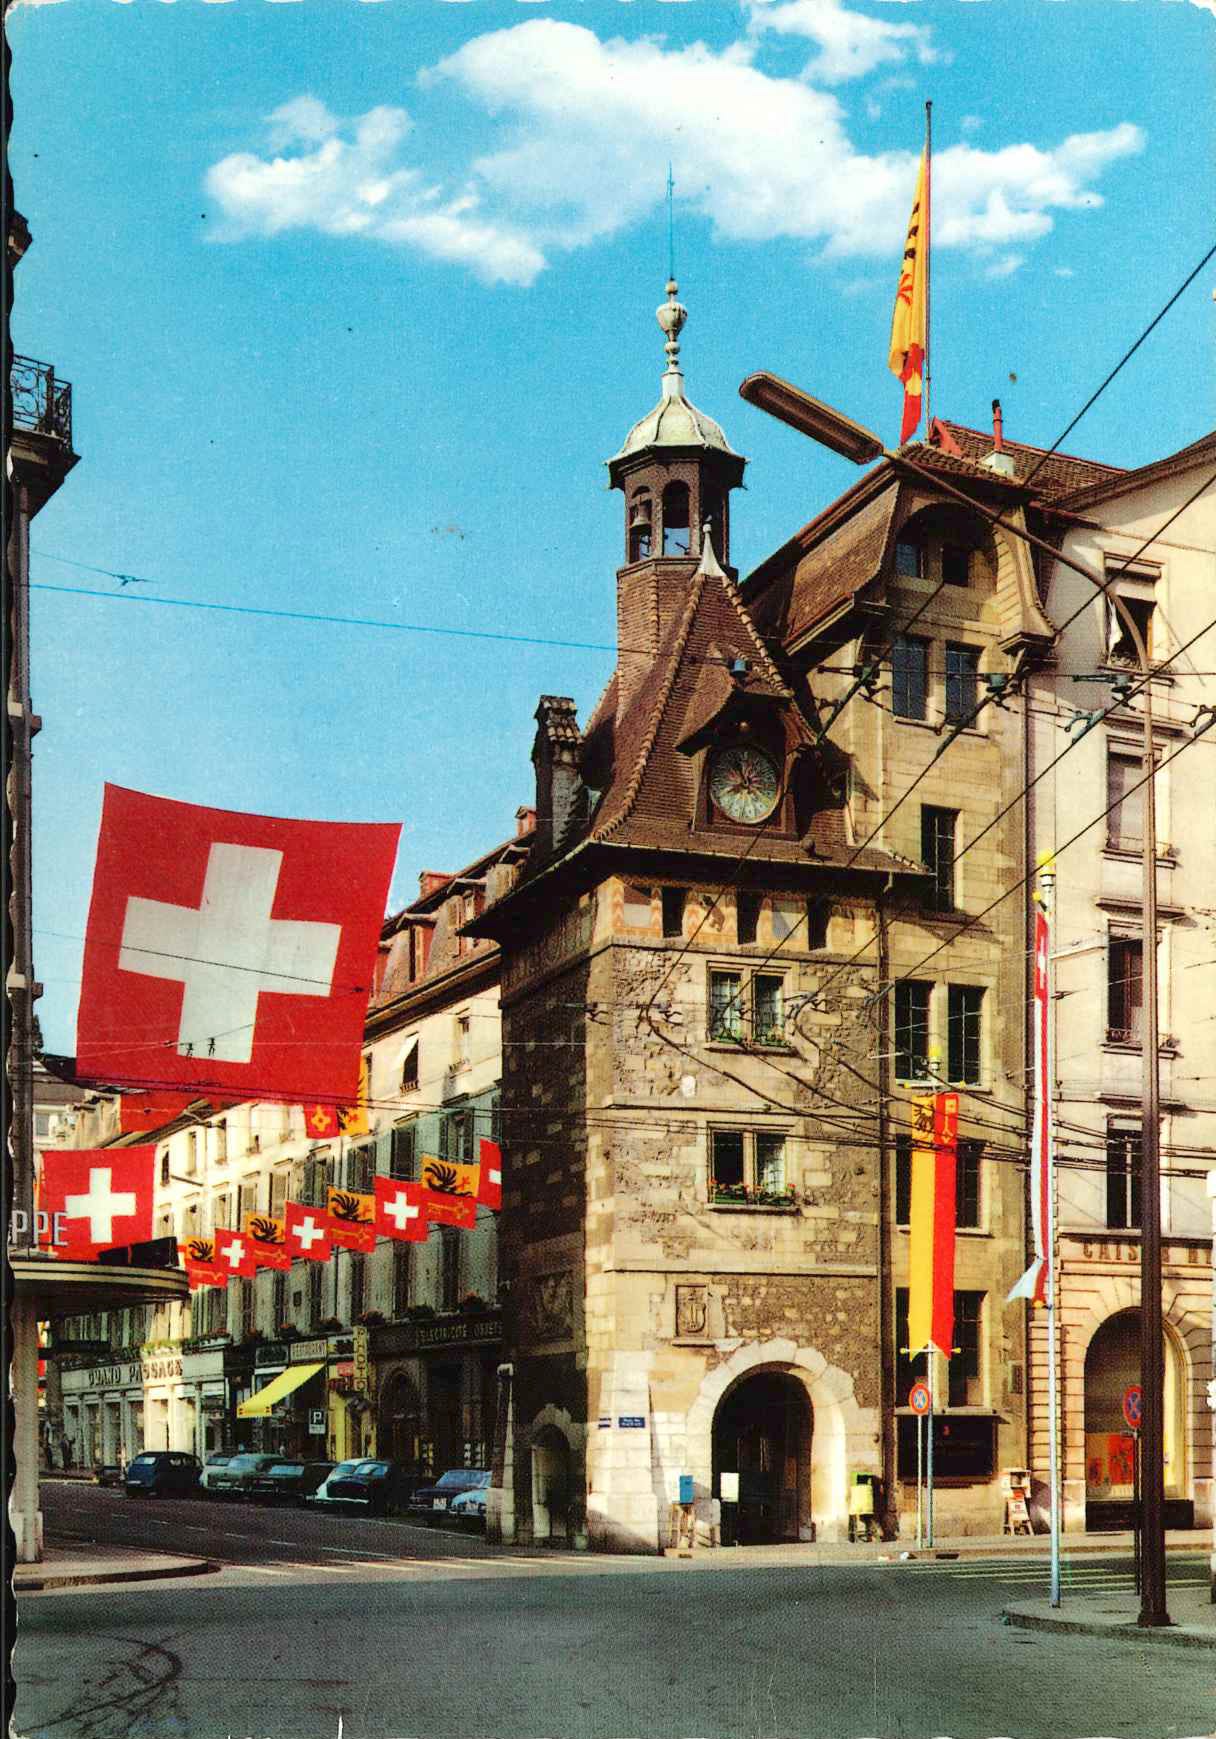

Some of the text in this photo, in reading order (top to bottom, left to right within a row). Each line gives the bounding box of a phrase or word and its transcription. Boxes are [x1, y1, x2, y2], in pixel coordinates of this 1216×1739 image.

[129, 1358, 184, 1384] PASSAGE
[355, 1327, 367, 1392] PHOTO
[313, 1410, 323, 1424] P
